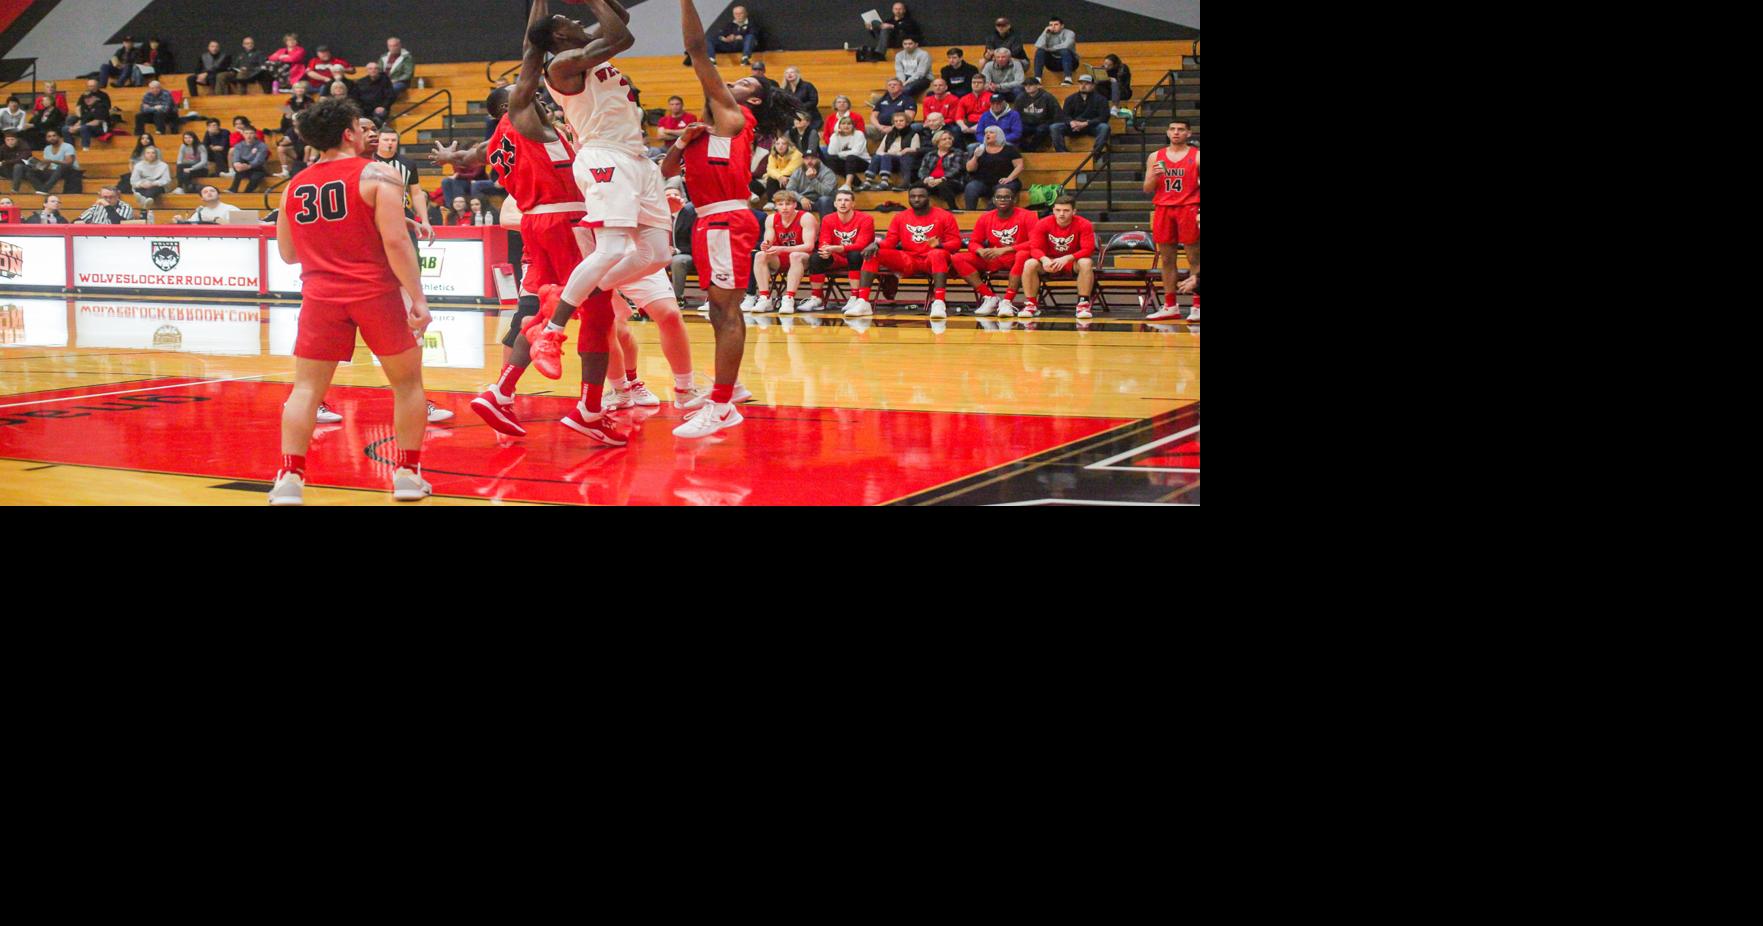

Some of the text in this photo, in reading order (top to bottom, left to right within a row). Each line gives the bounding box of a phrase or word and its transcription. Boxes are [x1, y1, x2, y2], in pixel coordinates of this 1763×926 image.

[589, 166, 616, 183] W
[1165, 178, 1182, 192] 14
[294, 179, 348, 224] 30
[79, 273, 258, 287] WOLVESLOCKERROOM.COM
